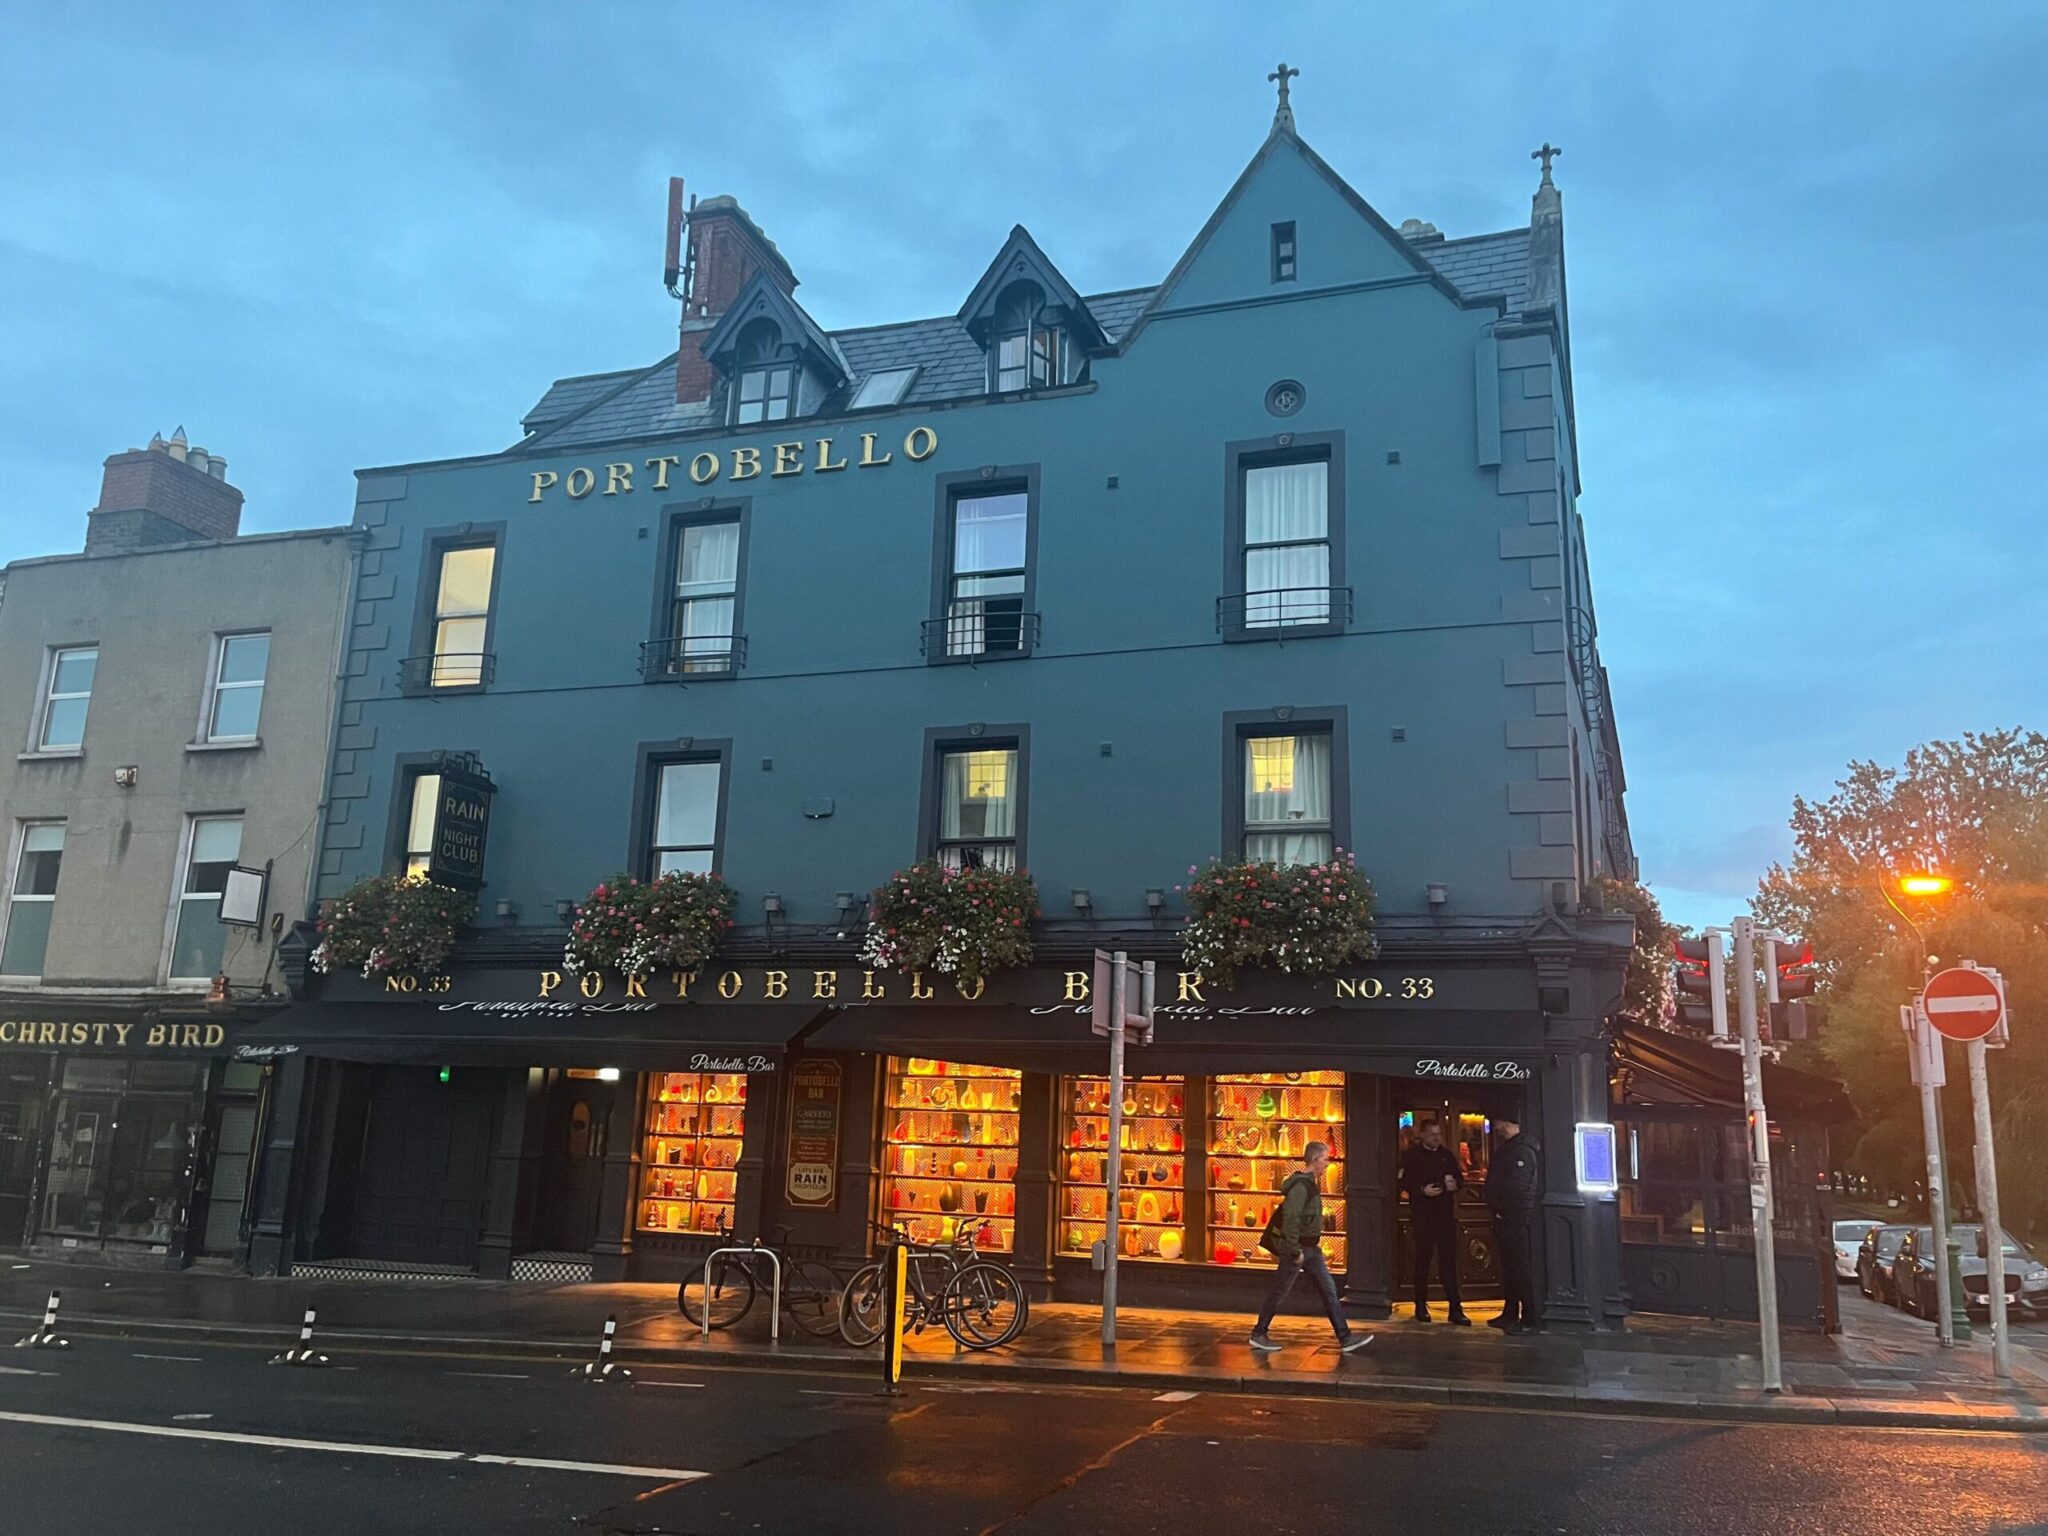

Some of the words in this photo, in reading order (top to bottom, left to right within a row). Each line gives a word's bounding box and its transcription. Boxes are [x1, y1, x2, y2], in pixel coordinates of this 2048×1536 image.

[528, 426, 938, 503] PORTOBELLO
[445, 797, 485, 821] RAIN
[443, 828, 479, 848] NIGHT
[442, 842, 478, 863] CLUB
[384, 975, 422, 992] NO.
[428, 975, 451, 992] 33
[1063, 971, 1207, 1002] BR
[1335, 977, 1392, 999] NO.
[1401, 977, 1434, 999] 33
[0, 1021, 133, 1046] CHRISTY
[146, 1024, 225, 1047] BIRD
[689, 1053, 745, 1070] Portobello
[747, 1055, 775, 1072] Bar
[1415, 1059, 1490, 1079] Portobello
[1493, 1061, 1532, 1080] Bar
[794, 1173, 827, 1184] RAIN
